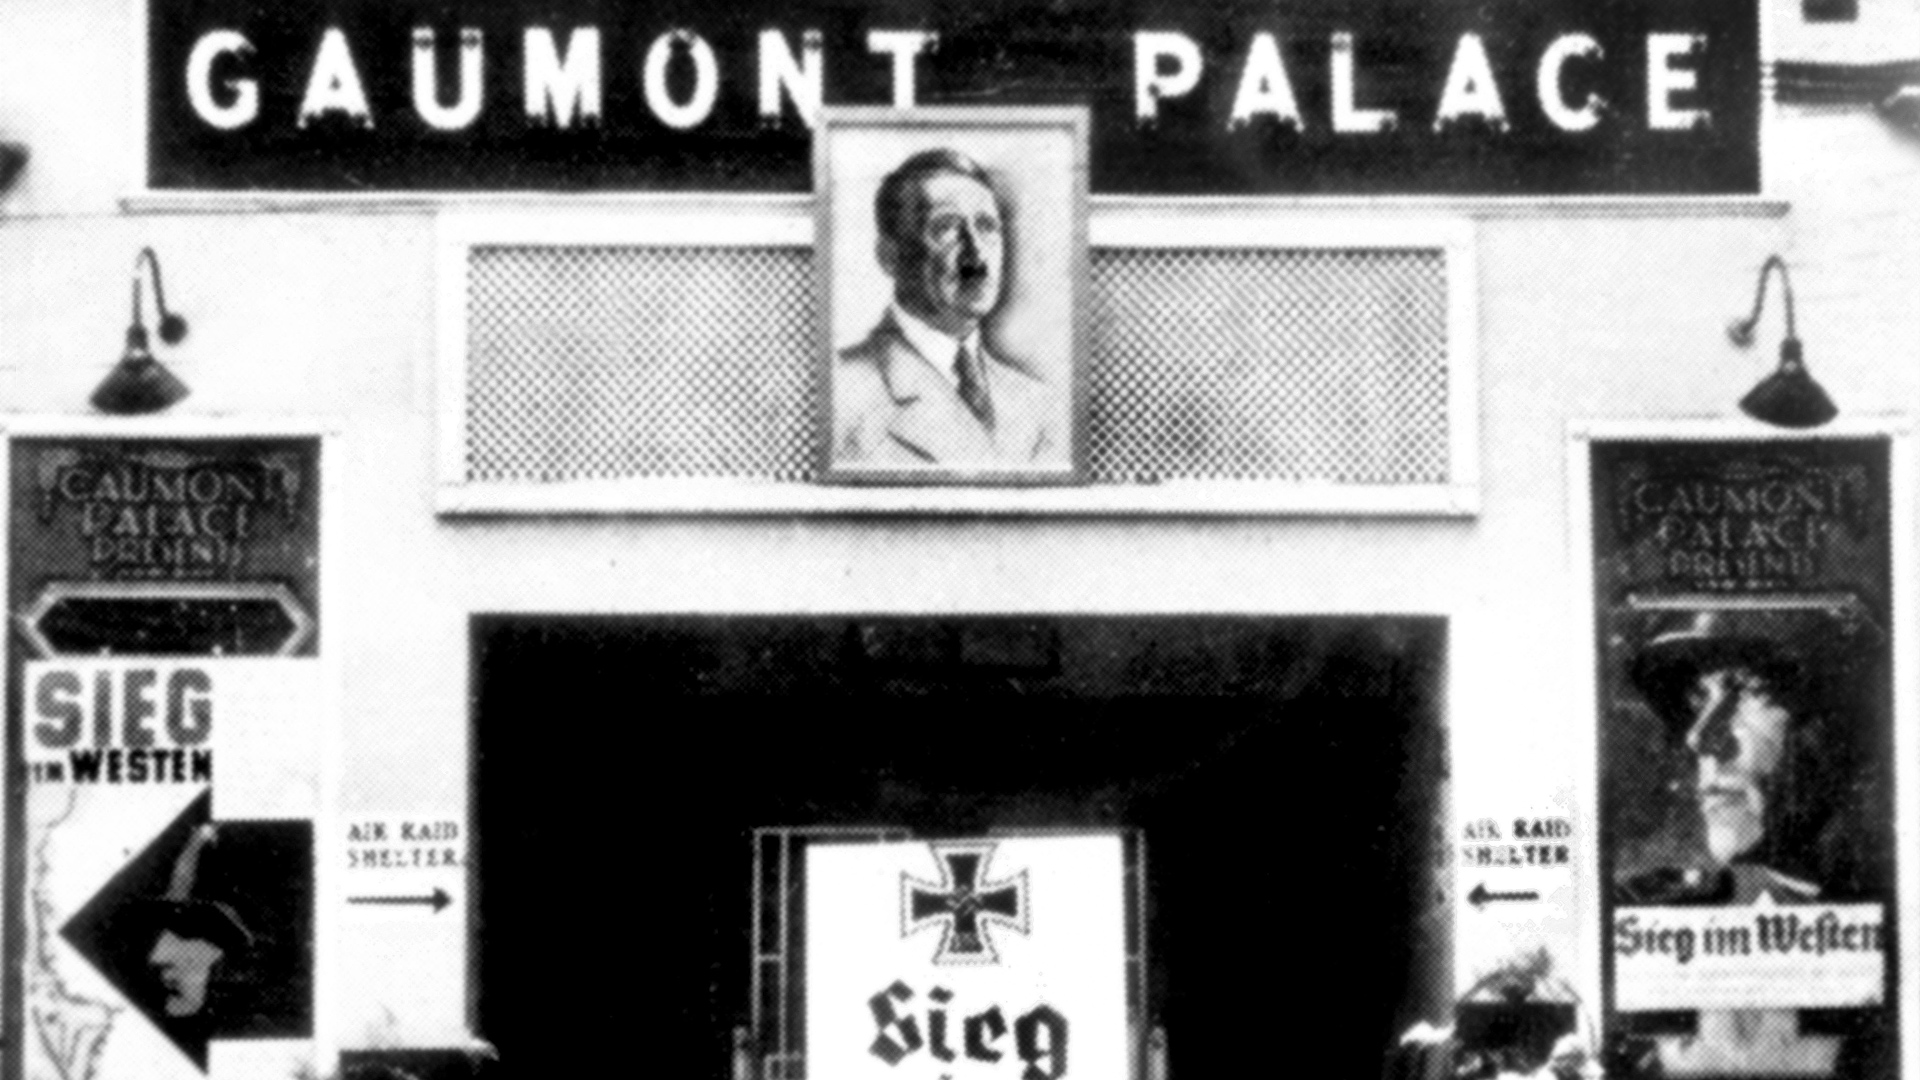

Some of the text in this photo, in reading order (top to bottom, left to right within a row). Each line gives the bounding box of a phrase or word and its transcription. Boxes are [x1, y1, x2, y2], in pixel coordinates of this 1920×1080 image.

[186, 27, 1710, 133] GAUMONT PALACE
[34, 668, 212, 748] SIEG
[69, 749, 212, 784] WESTEN
[347, 820, 459, 842] AIR RAID
[1463, 817, 1572, 841] AIR RAID
[347, 847, 459, 869] SHELTER
[1616, 914, 1696, 964] Sieg
[1703, 916, 1751, 956] im
[867, 978, 1068, 1080] Sieg
